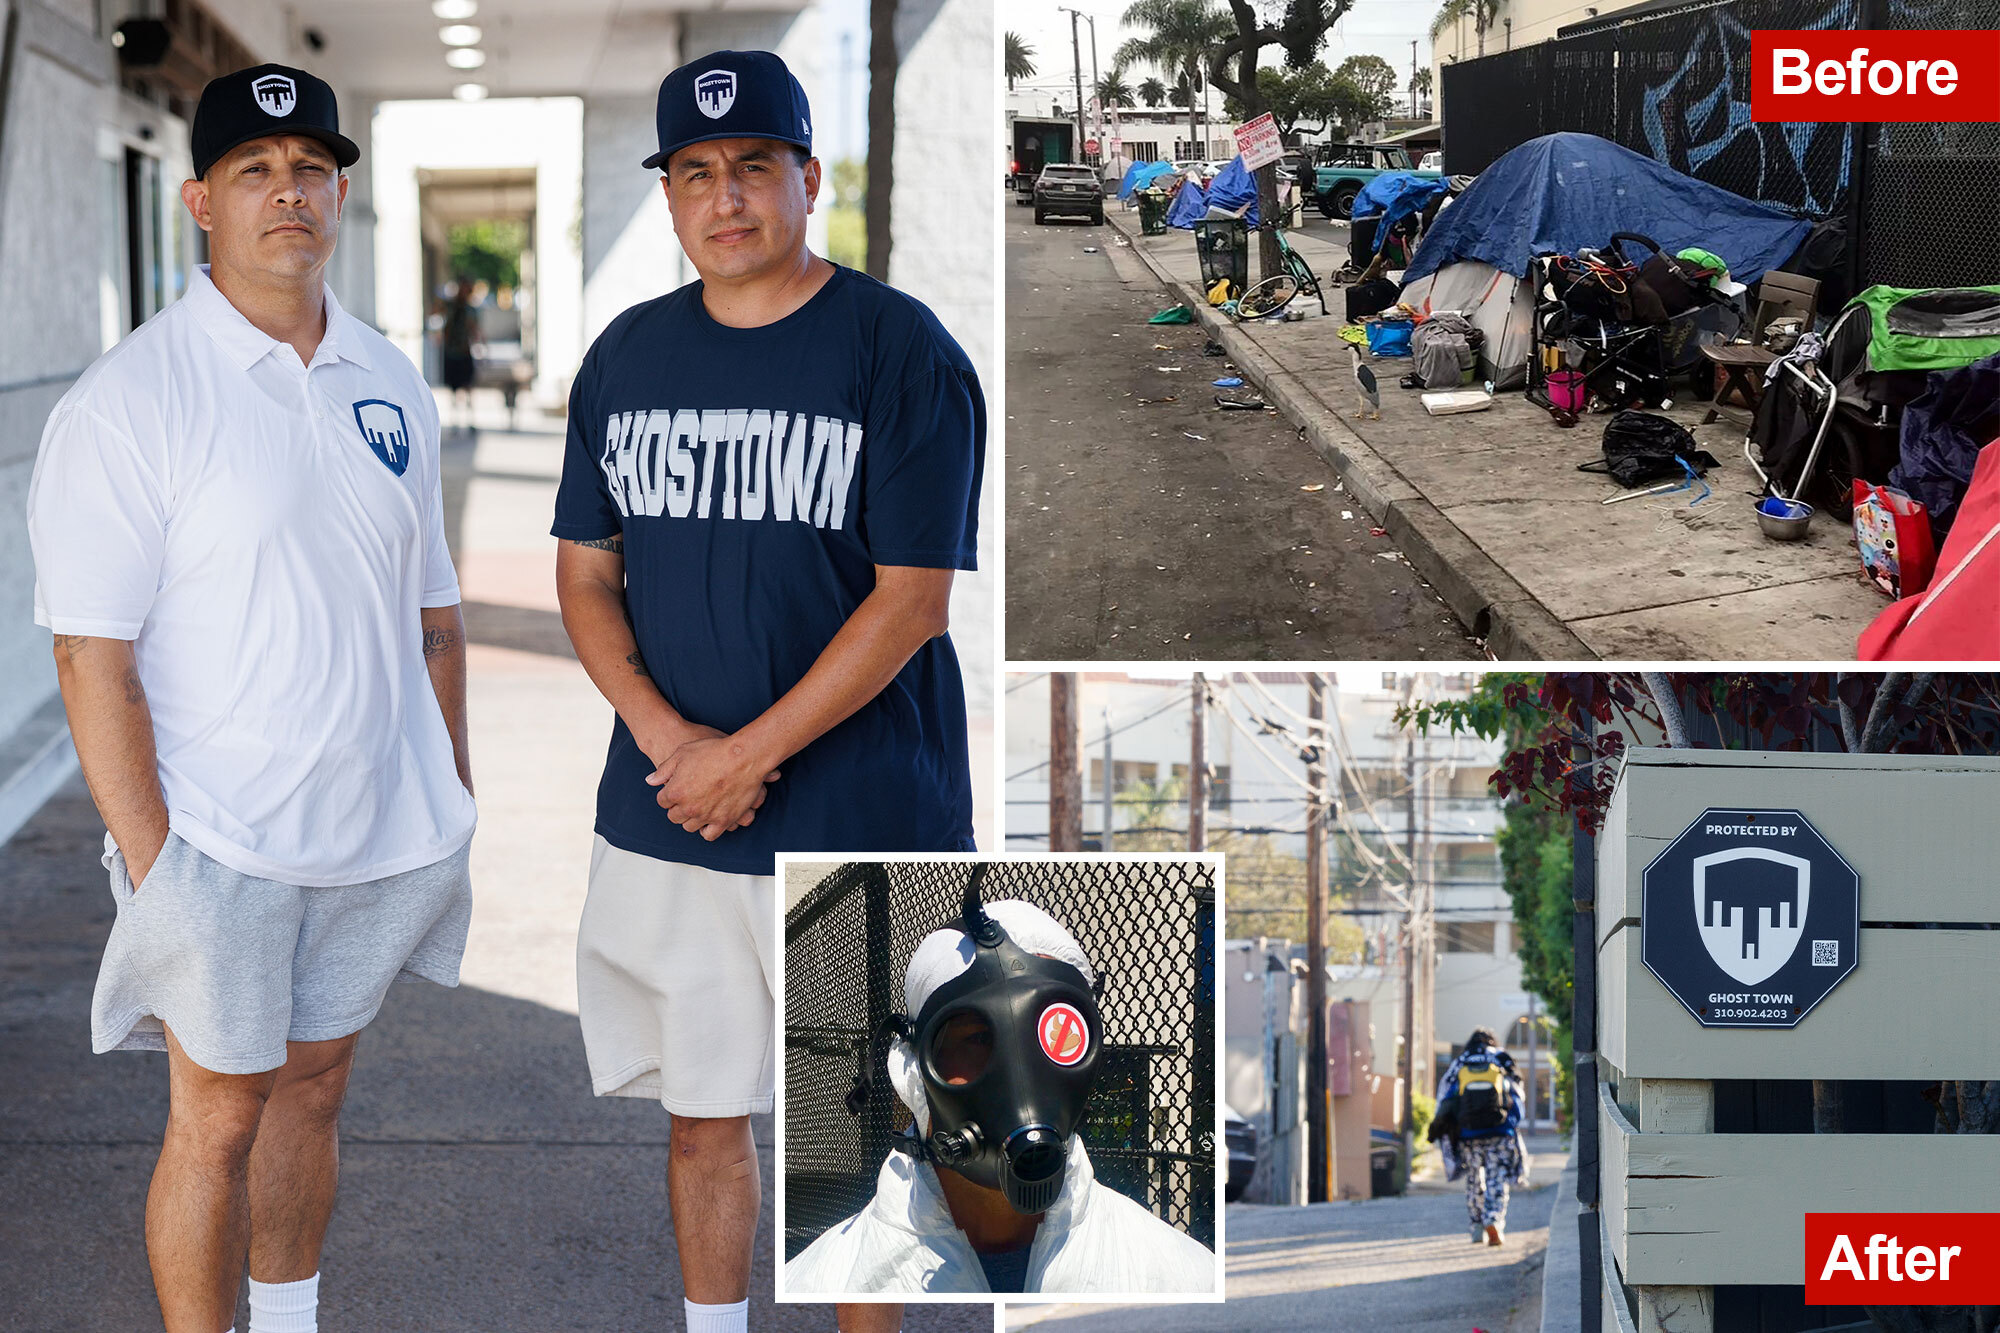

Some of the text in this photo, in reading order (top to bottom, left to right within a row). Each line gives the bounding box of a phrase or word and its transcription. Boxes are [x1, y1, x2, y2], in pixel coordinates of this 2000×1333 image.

[699, 78, 731, 88] GHOSTTOWN
[1238, 135, 1252, 151] NO
[1250, 125, 1275, 145] PARKING
[600, 408, 864, 531] GHOSTTOWN
[1706, 824, 1798, 837] PROTECTED BY
[1708, 992, 1794, 1005] GHOST TOWN
[1714, 1008, 1788, 1019] 310.902.4203
